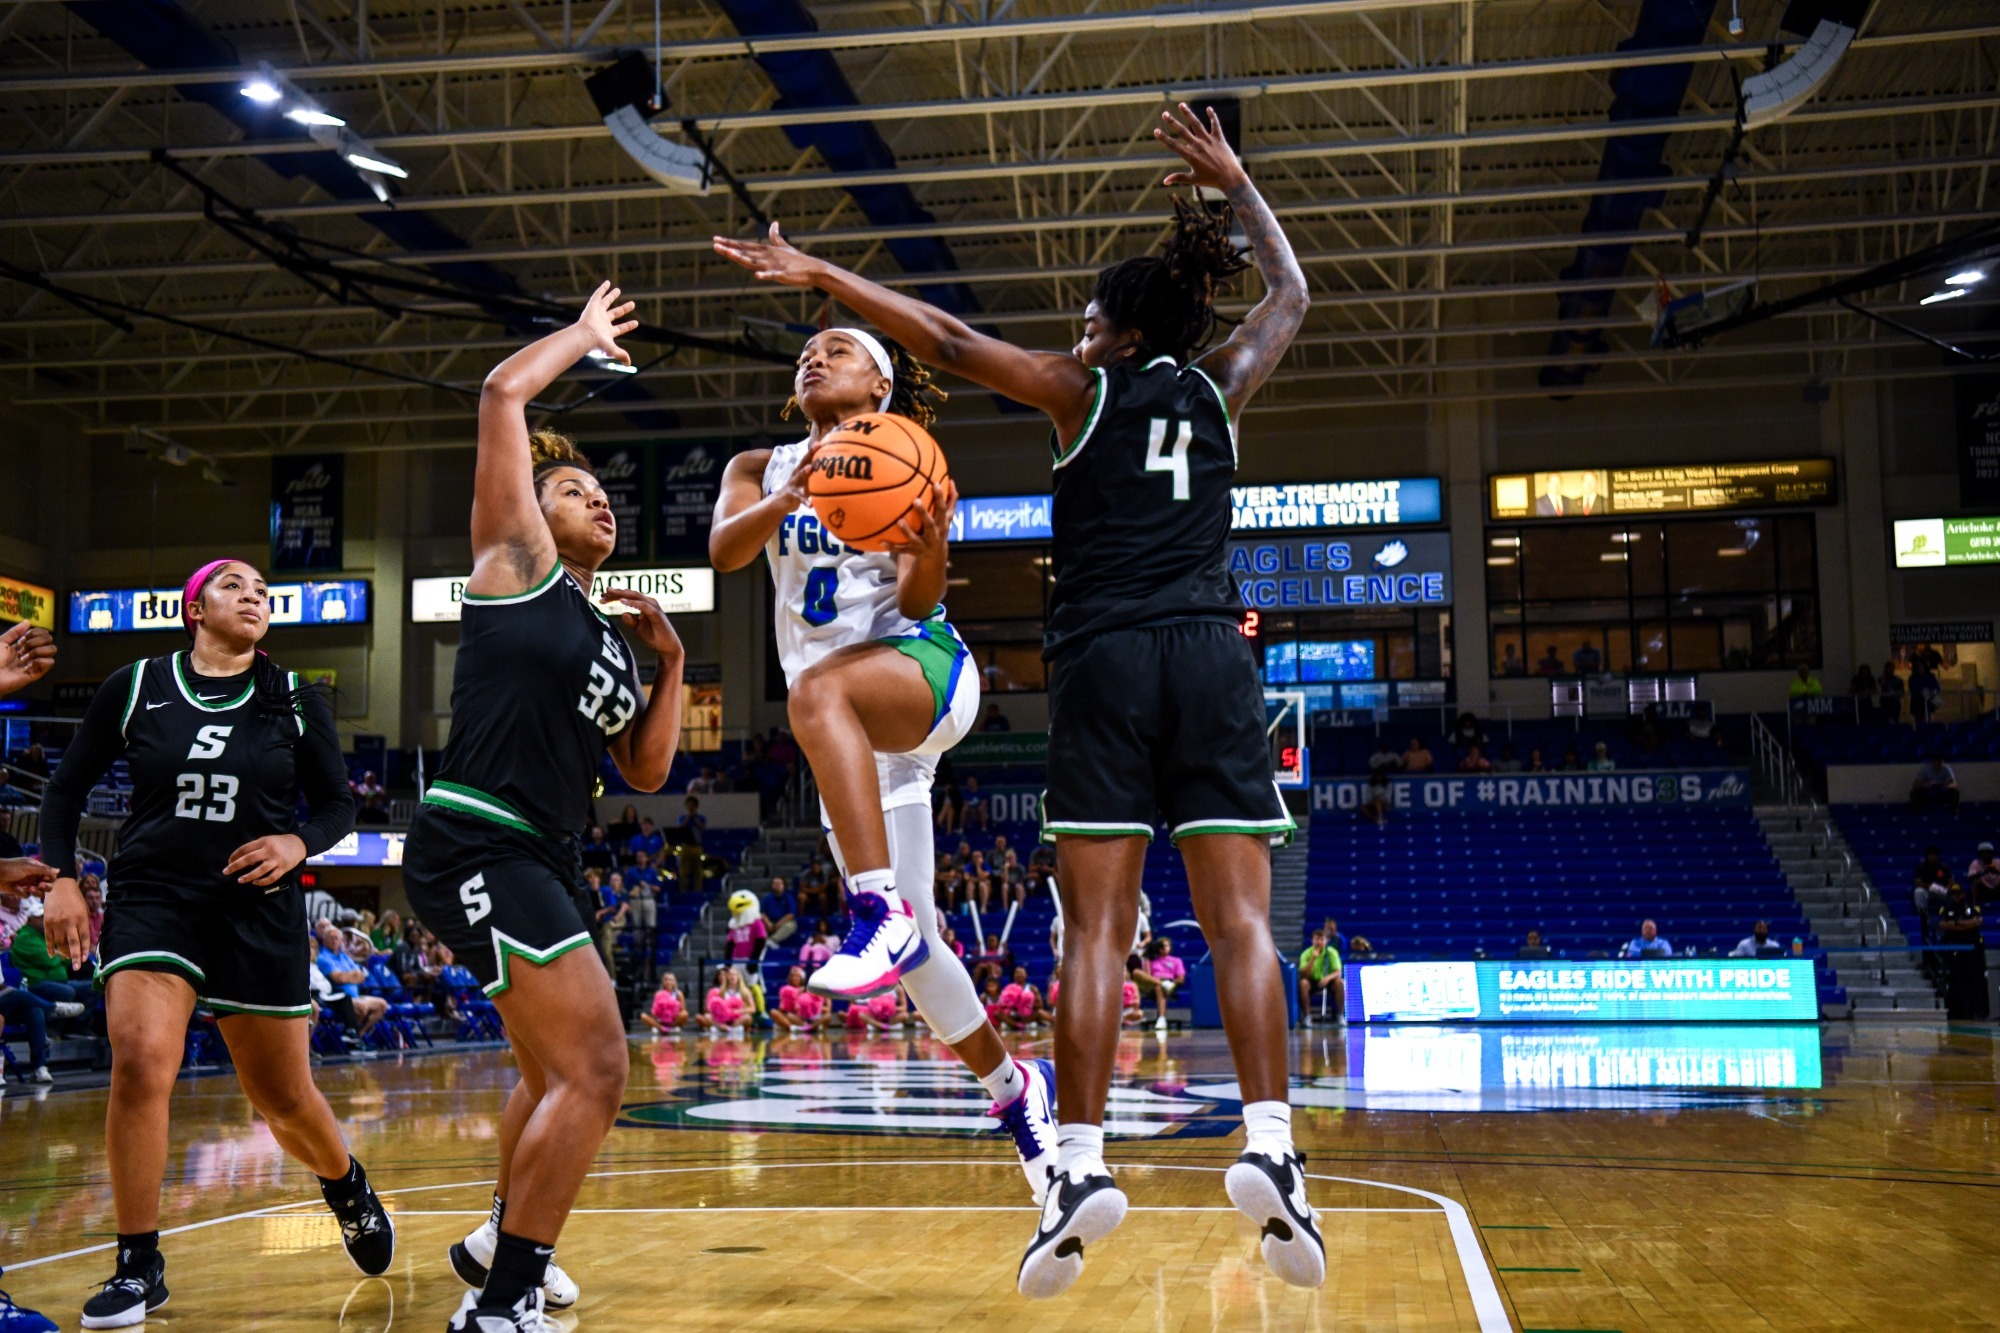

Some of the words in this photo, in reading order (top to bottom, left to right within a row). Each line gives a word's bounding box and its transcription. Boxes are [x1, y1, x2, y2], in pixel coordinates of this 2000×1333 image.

[1145, 418, 1192, 500] 4
[971, 497, 1052, 536] hospital
[1322, 500, 1400, 525] SUITE
[1946, 521, 1994, 534] Artichoke
[1229, 542, 1352, 575] AGLES
[592, 573, 684, 598] ACTORS
[801, 566, 839, 627] 0
[1240, 571, 1444, 608] XCELLENCE
[577, 660, 637, 736] 33
[175, 773, 240, 823] 23
[1424, 781, 1465, 807] OF
[459, 871, 492, 927] S
[1499, 970, 1587, 990] EAGLES
[1591, 970, 1647, 989] RIDE
[1650, 969, 1714, 989] WITH
[1719, 968, 1792, 988] PRIDE
